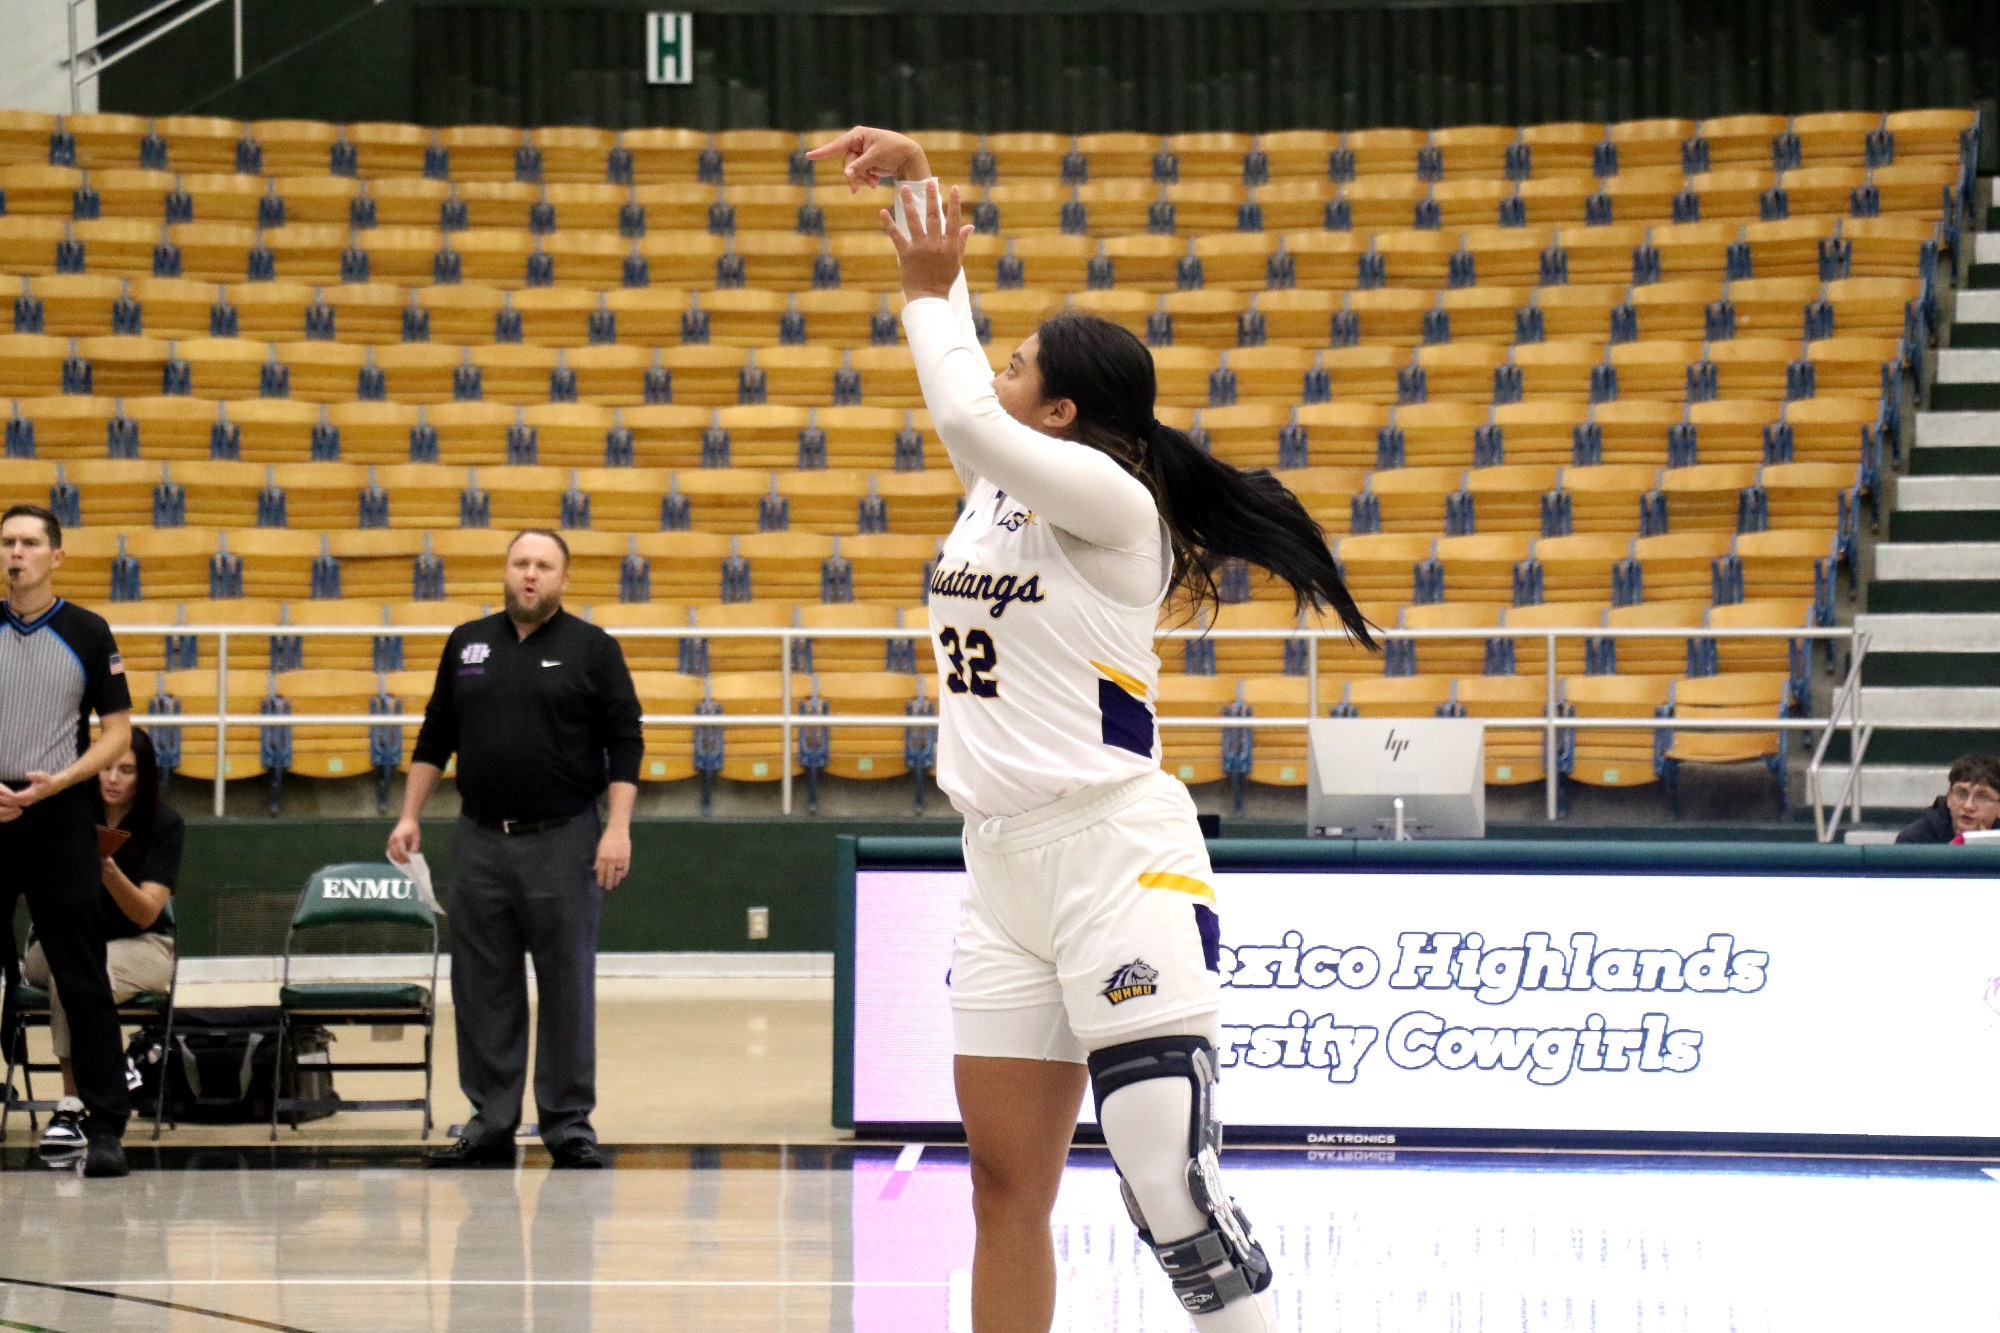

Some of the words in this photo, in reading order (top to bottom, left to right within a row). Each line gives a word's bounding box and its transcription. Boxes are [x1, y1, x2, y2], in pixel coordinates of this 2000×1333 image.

[657, 15, 682, 79] H
[931, 550, 1045, 619] ustangs
[939, 625, 1000, 699] 32
[1384, 728, 1410, 762] hp
[322, 877, 414, 900] ENMU
[1108, 985, 1153, 1004] WNMU
[1219, 930, 1381, 990] exico
[1389, 931, 1770, 1005] Highlands
[1385, 1010, 1703, 1086] Cowgirls
[1306, 1132, 1396, 1144] DAKTRONICS
